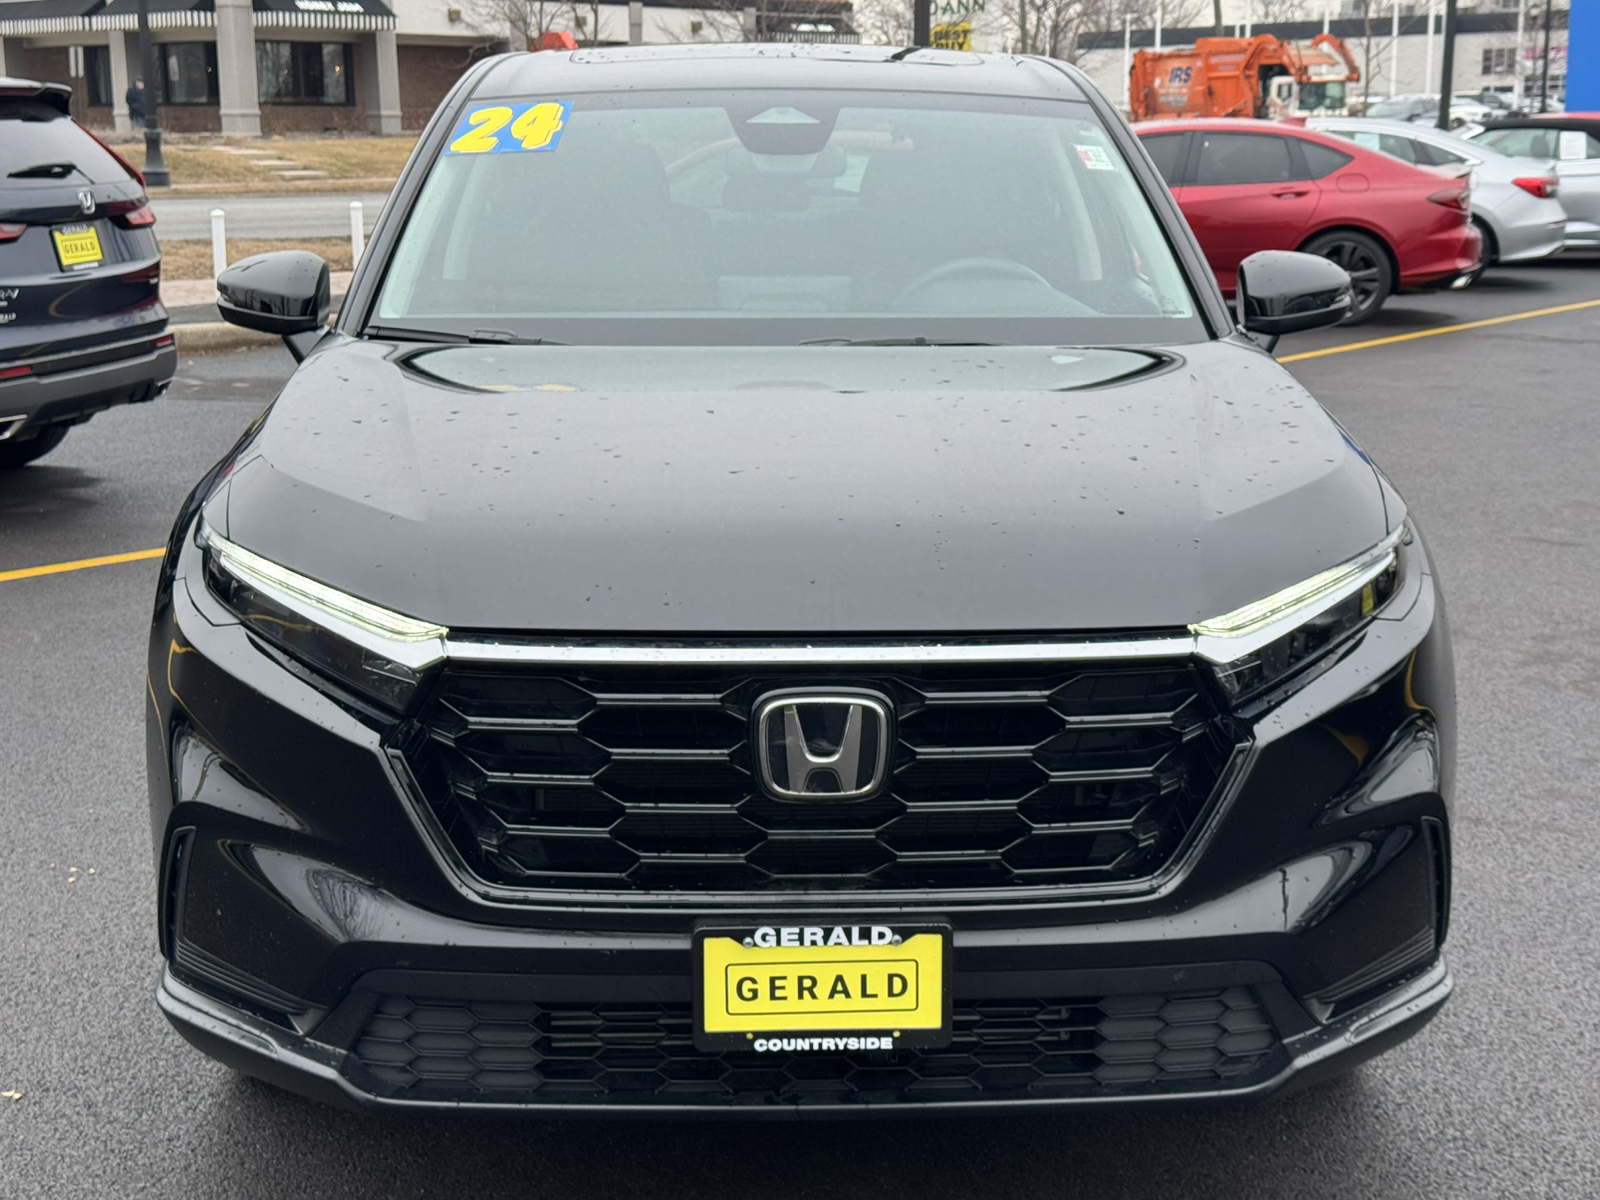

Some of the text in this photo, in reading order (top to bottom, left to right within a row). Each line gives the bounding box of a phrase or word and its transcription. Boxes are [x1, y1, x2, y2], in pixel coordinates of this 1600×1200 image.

[1169, 66, 1192, 84] IRS
[450, 103, 564, 153] 24
[64, 241, 96, 254] GERALD
[754, 926, 893, 948] GERALD
[736, 973, 909, 1002] GERALD
[754, 1037, 893, 1052] COUNTRYSIDE
